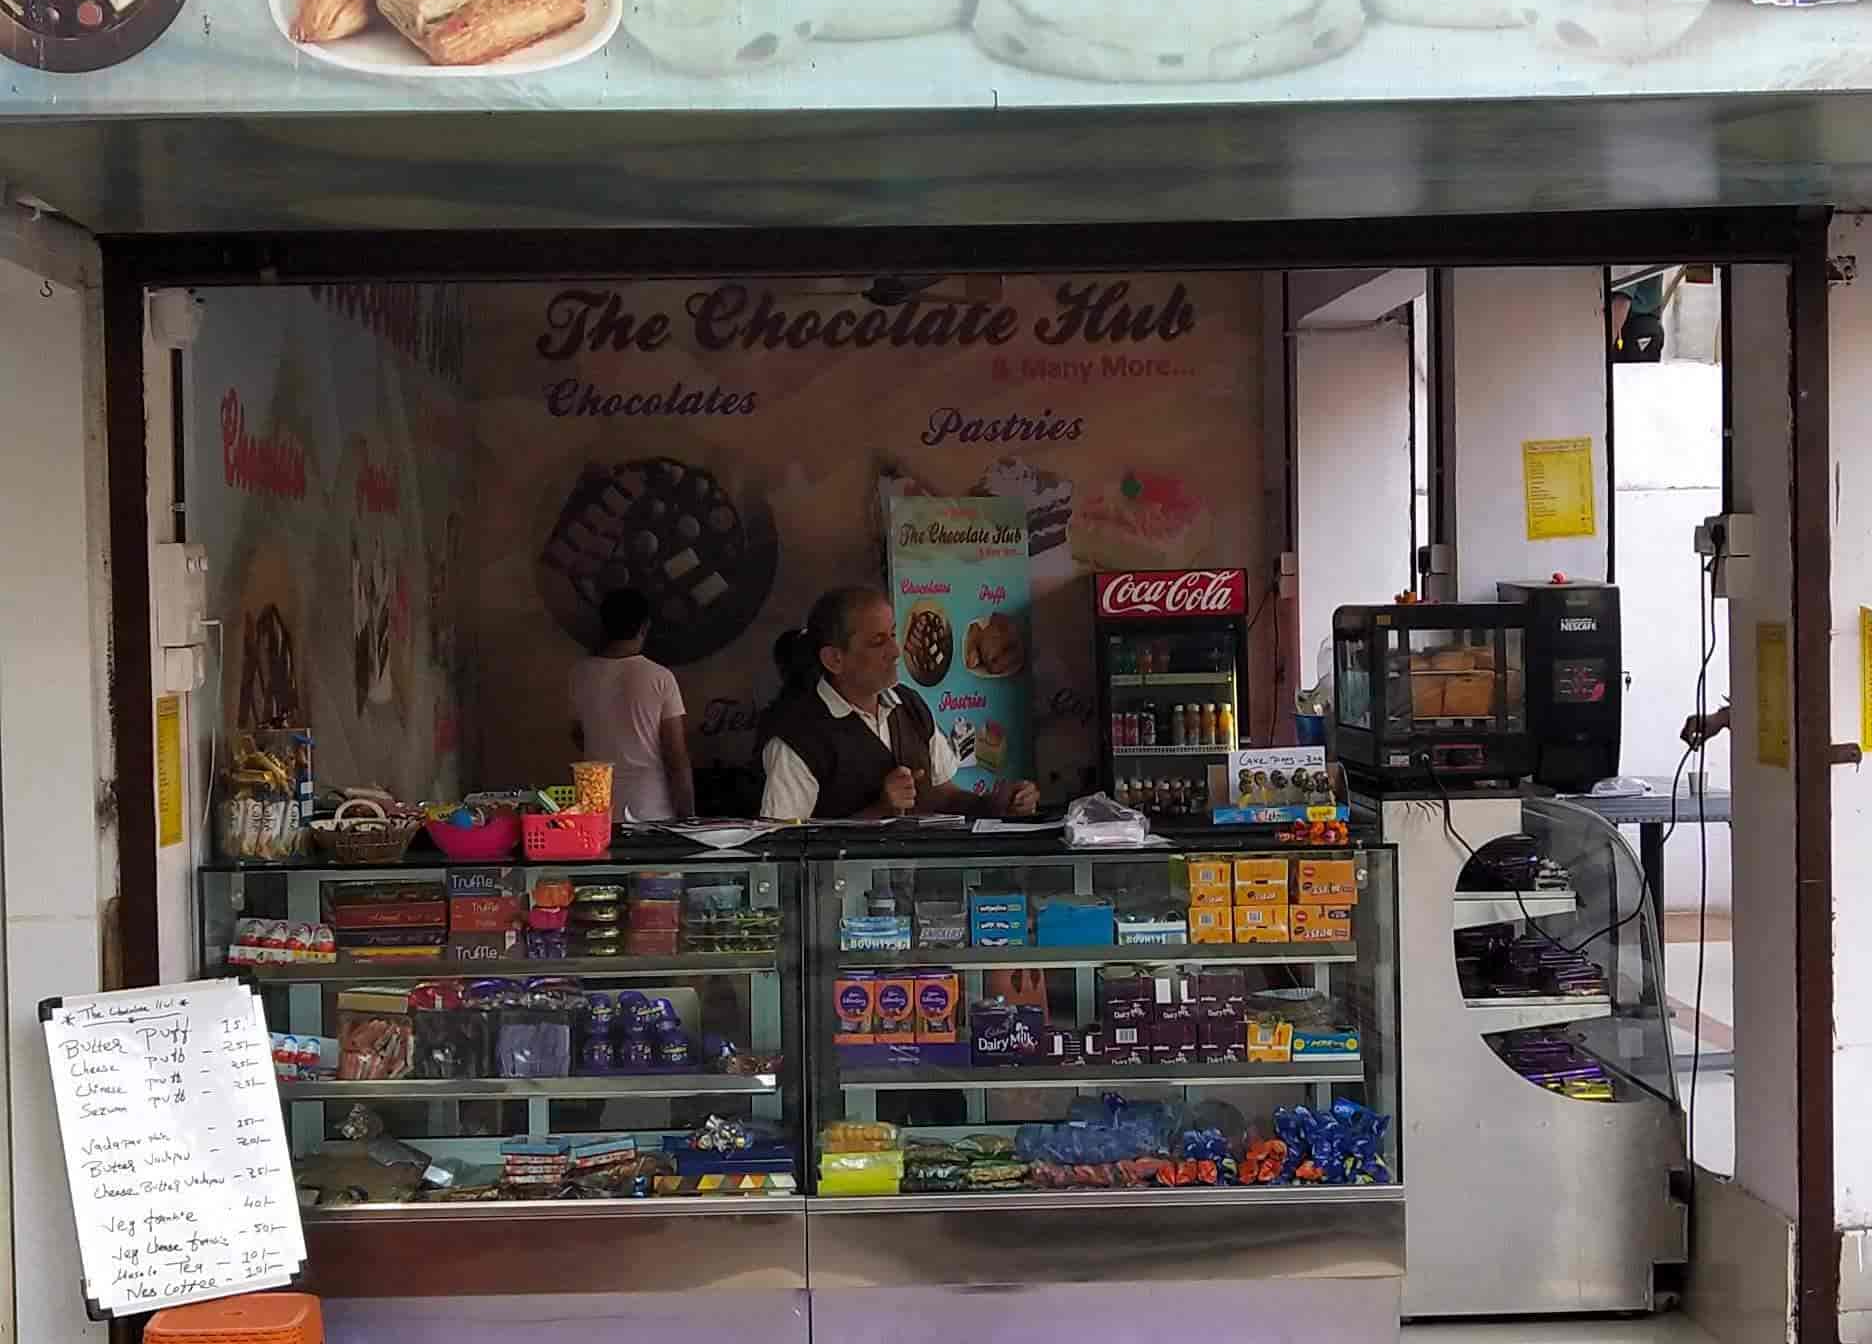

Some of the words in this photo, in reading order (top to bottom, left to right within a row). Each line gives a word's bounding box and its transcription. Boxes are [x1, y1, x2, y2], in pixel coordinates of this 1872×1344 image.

[536, 289, 671, 360] The
[685, 285, 1018, 349] Chocolate
[1034, 280, 1195, 345] Hub
[1021, 356, 1094, 383] Many
[544, 378, 760, 417] Chocolates
[920, 407, 1084, 445] Pastries
[900, 520, 925, 546] The
[927, 521, 990, 545] Chocolate
[991, 522, 1022, 545] Hub
[1102, 570, 1240, 613] Coca-Cola
[451, 873, 495, 889] Truffle
[455, 944, 498, 961] Truffle
[977, 1037, 1010, 1053] Dairy
